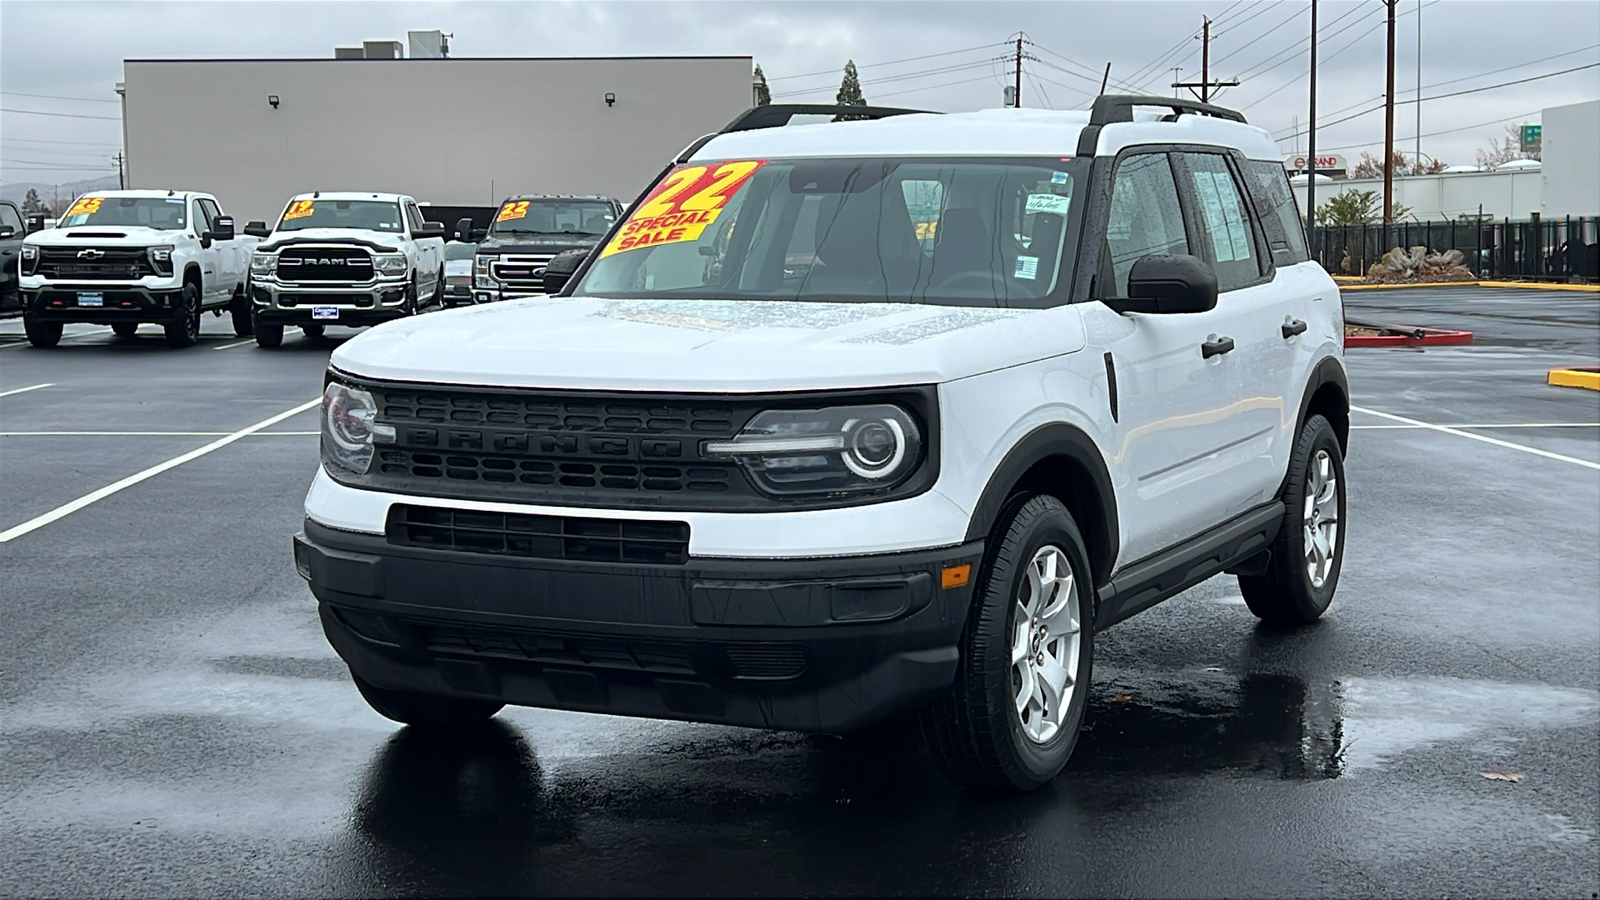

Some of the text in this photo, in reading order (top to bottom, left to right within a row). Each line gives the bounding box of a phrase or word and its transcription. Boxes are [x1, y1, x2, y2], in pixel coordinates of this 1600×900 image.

[632, 161, 757, 221] 22
[73, 198, 105, 210] 25
[288, 200, 313, 214] 19
[500, 201, 531, 214] 22
[622, 210, 710, 237] SPECIAL
[617, 228, 687, 251] SALE
[408, 428, 682, 458] BRONCO
